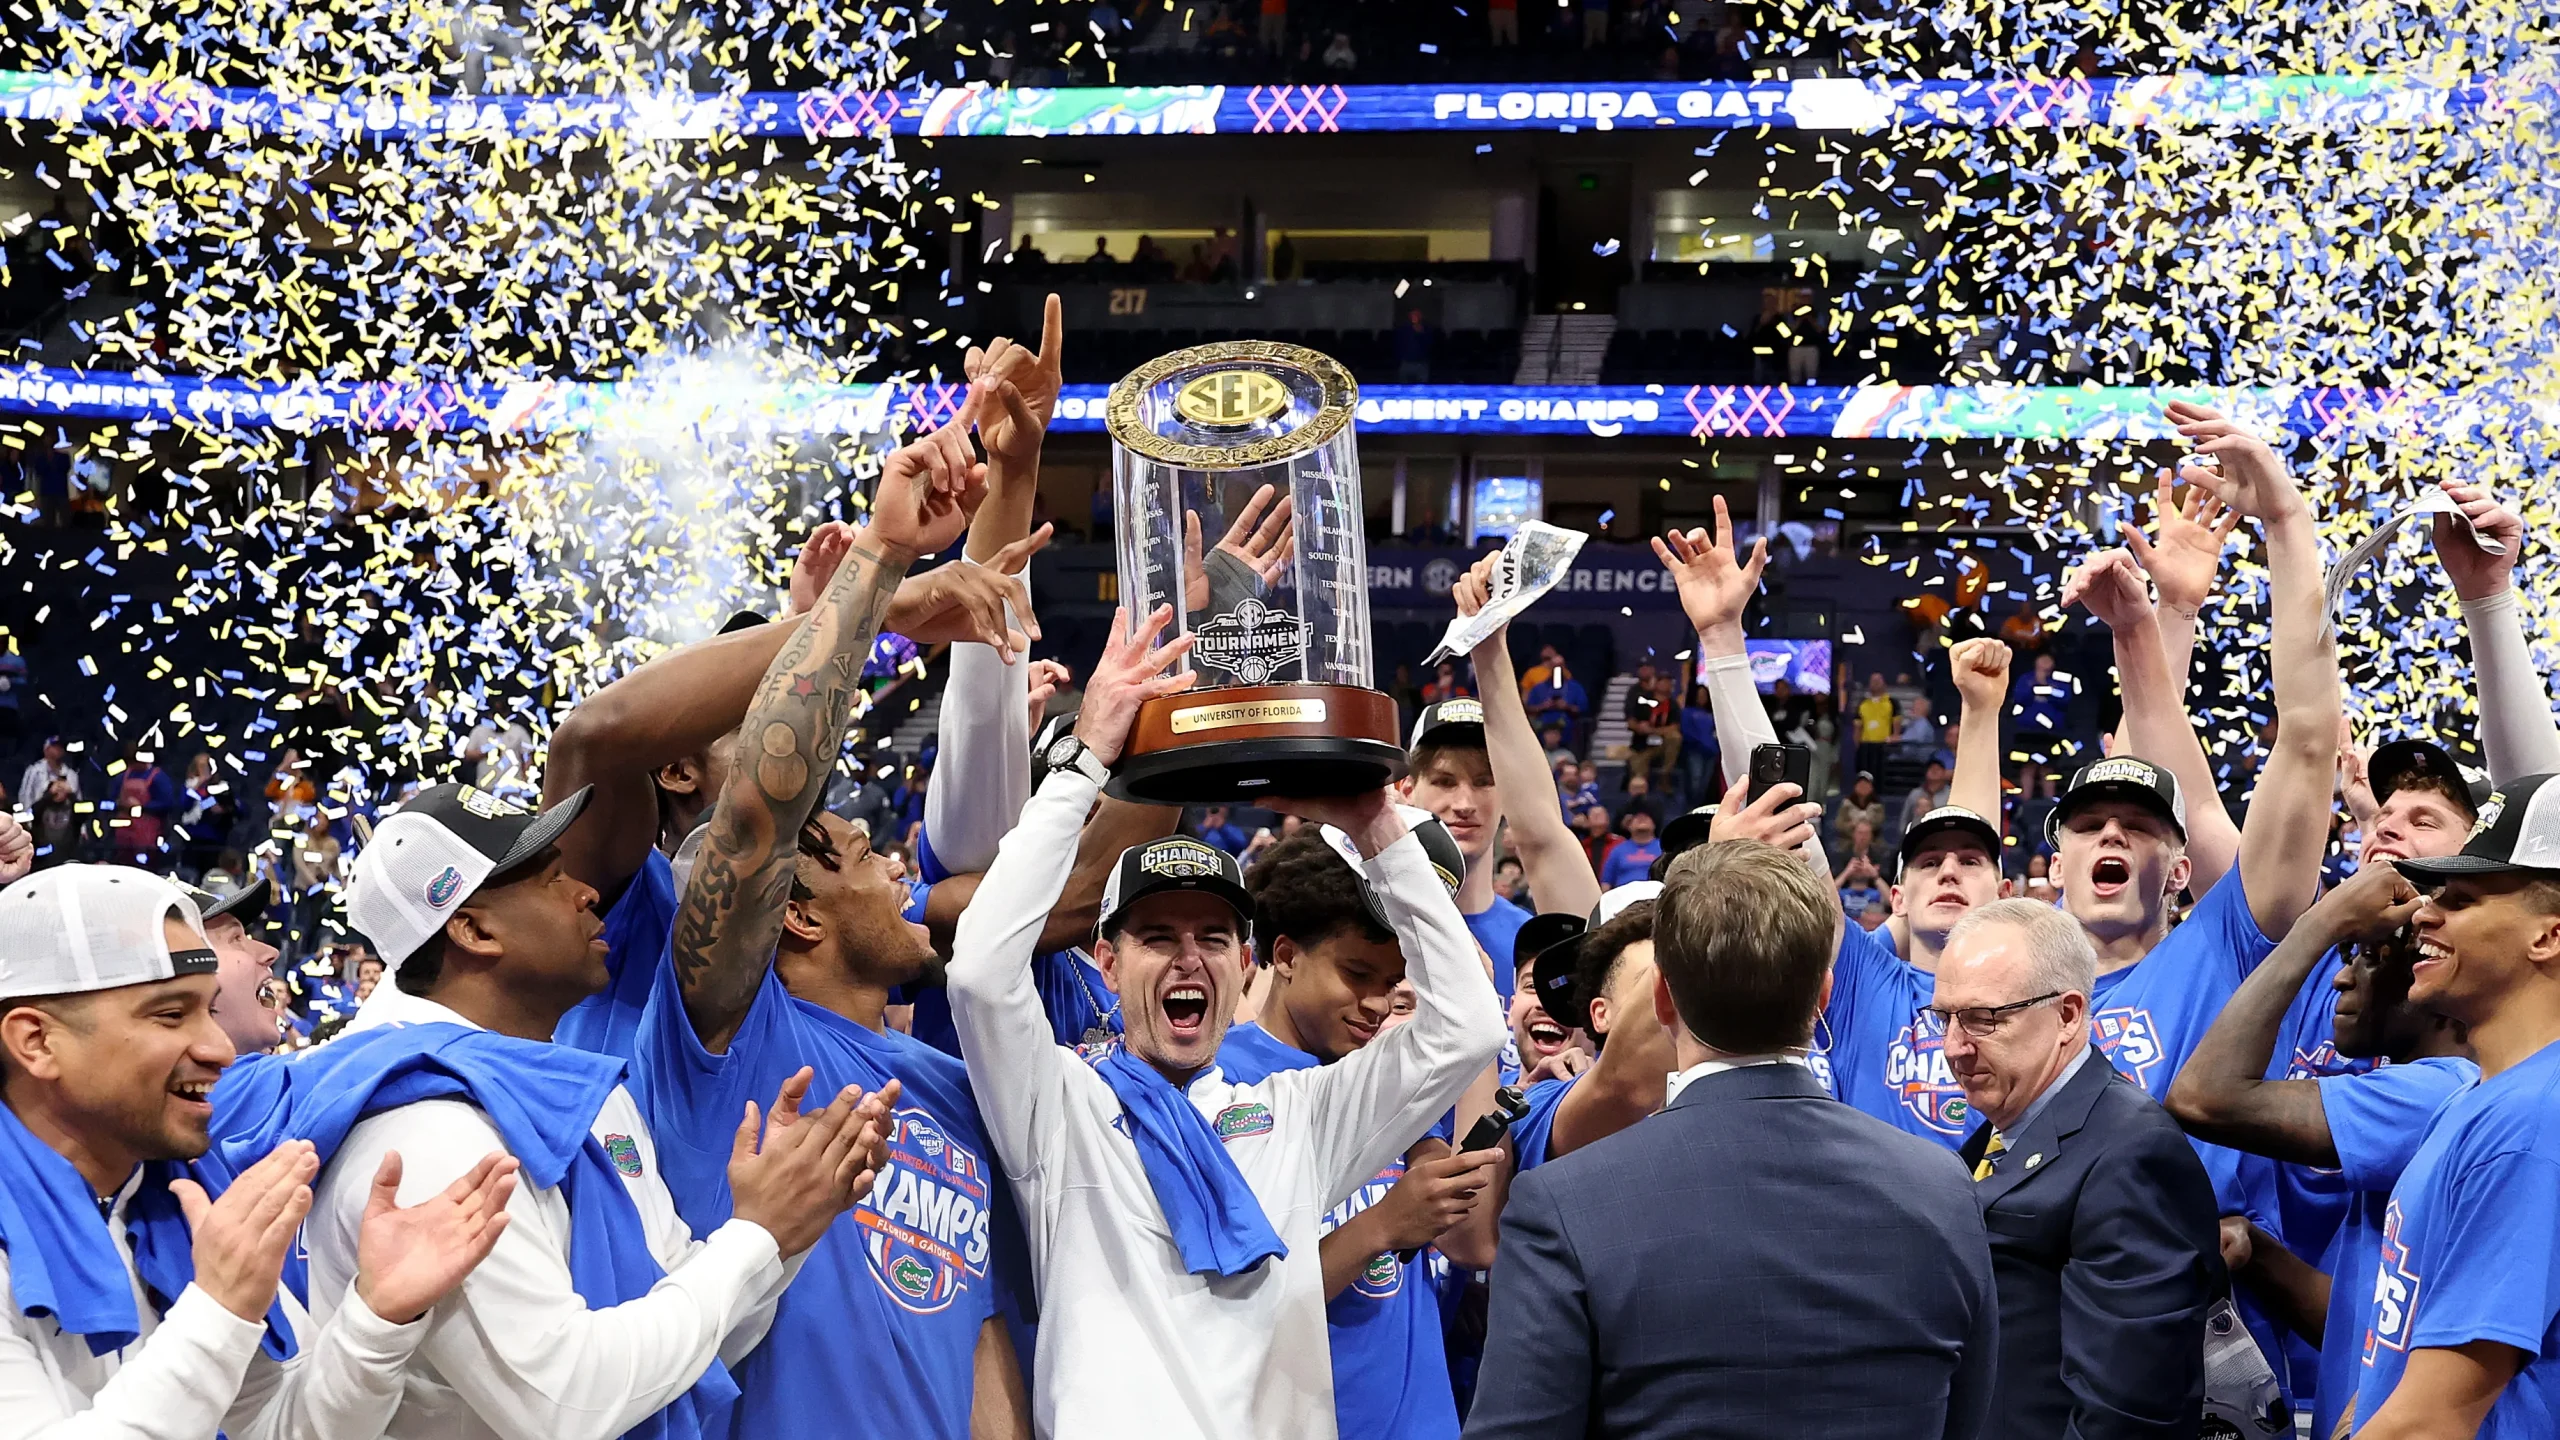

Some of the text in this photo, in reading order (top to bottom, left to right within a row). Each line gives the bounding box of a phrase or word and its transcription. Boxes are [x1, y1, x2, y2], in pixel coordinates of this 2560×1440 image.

[1434, 91, 1658, 119] FLORIDA
[1110, 288, 1147, 315] 217
[1188, 373, 1277, 419] SEC
[1499, 399, 1659, 422] CHAMPS
[1307, 551, 1334, 562] SOUTH
[1193, 706, 1302, 723] UNIVERSITY OF FLORIDA
[2090, 764, 2153, 784] CHAMPS
[1144, 847, 1219, 871] CHAMPS
[2105, 1022, 2118, 1034] 25
[890, 1148, 938, 1176] ASKETBALL
[954, 1157, 964, 1169] 25
[857, 1161, 989, 1264] HAMPS
[876, 1218, 916, 1246] FLORIDA
